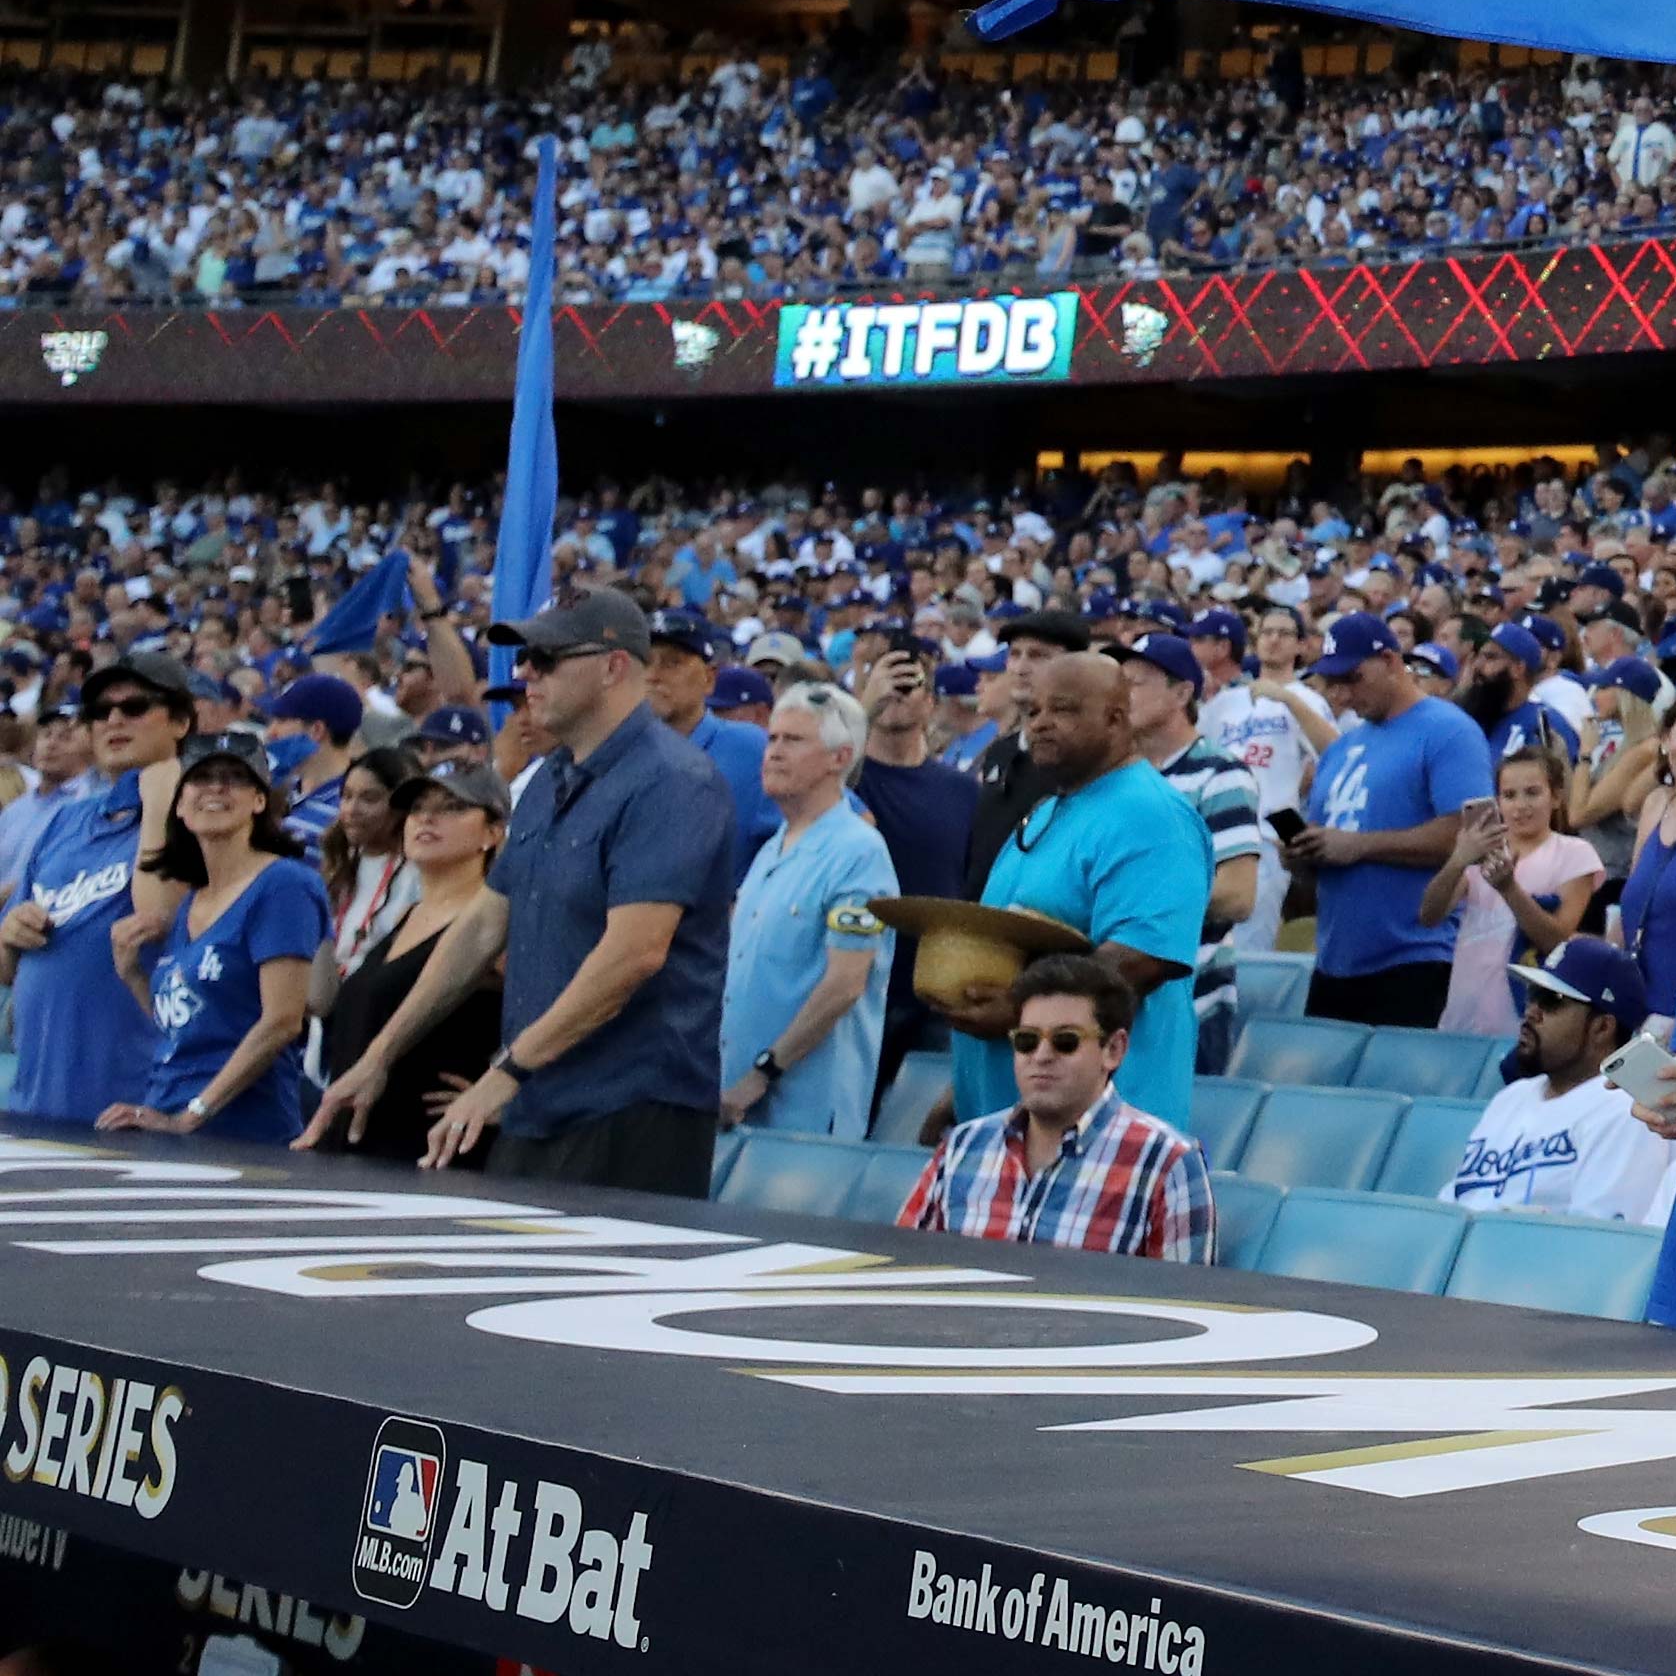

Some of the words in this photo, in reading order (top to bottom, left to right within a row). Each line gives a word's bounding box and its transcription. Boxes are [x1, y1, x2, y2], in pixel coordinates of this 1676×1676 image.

[791, 298, 1058, 379] #ITFDB
[1244, 745, 1274, 769] 22
[3, 1355, 187, 1520] SERIES
[357, 1535, 425, 1583] MLB.com
[429, 1458, 523, 1612] At
[516, 1479, 654, 1650] Bat
[907, 1549, 1002, 1635] Bank
[1002, 1572, 1046, 1644] of
[1040, 1577, 1206, 1676] America
